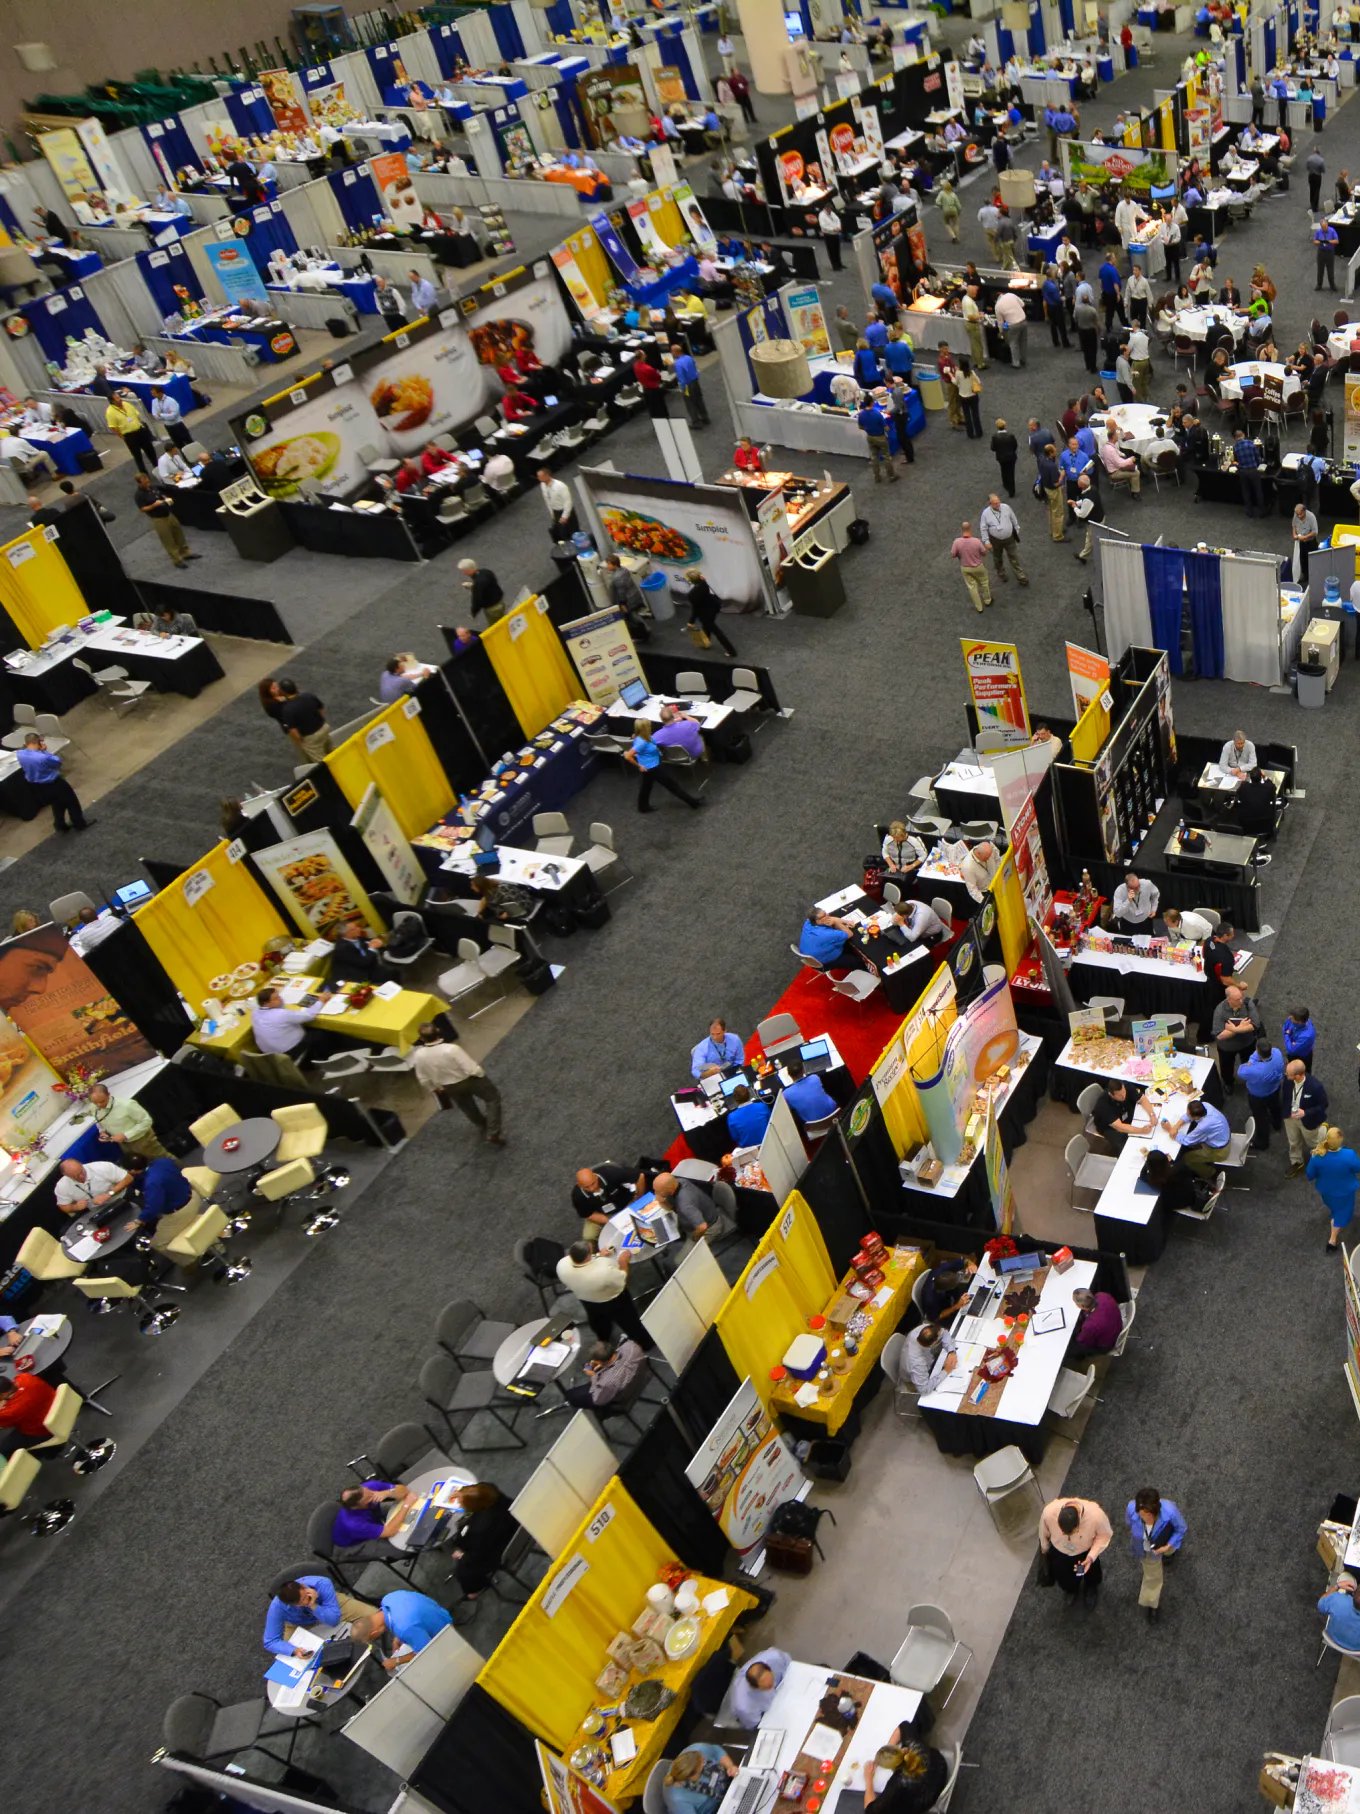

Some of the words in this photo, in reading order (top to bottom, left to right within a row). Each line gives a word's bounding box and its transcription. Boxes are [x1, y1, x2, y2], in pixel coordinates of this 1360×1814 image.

[1104, 161, 1134, 171] DIAMOND
[1264, 386, 1281, 399] Coffee
[1263, 393, 1282, 406] Service
[695, 522, 729, 535] Simplot
[973, 651, 1012, 664] PEAK
[974, 682, 1017, 692] Performers
[975, 689, 1007, 698] Supplier
[50, 1023, 137, 1068] Smithfield
[782, 1212, 793, 1235] 512
[590, 1511, 611, 1536] 510
